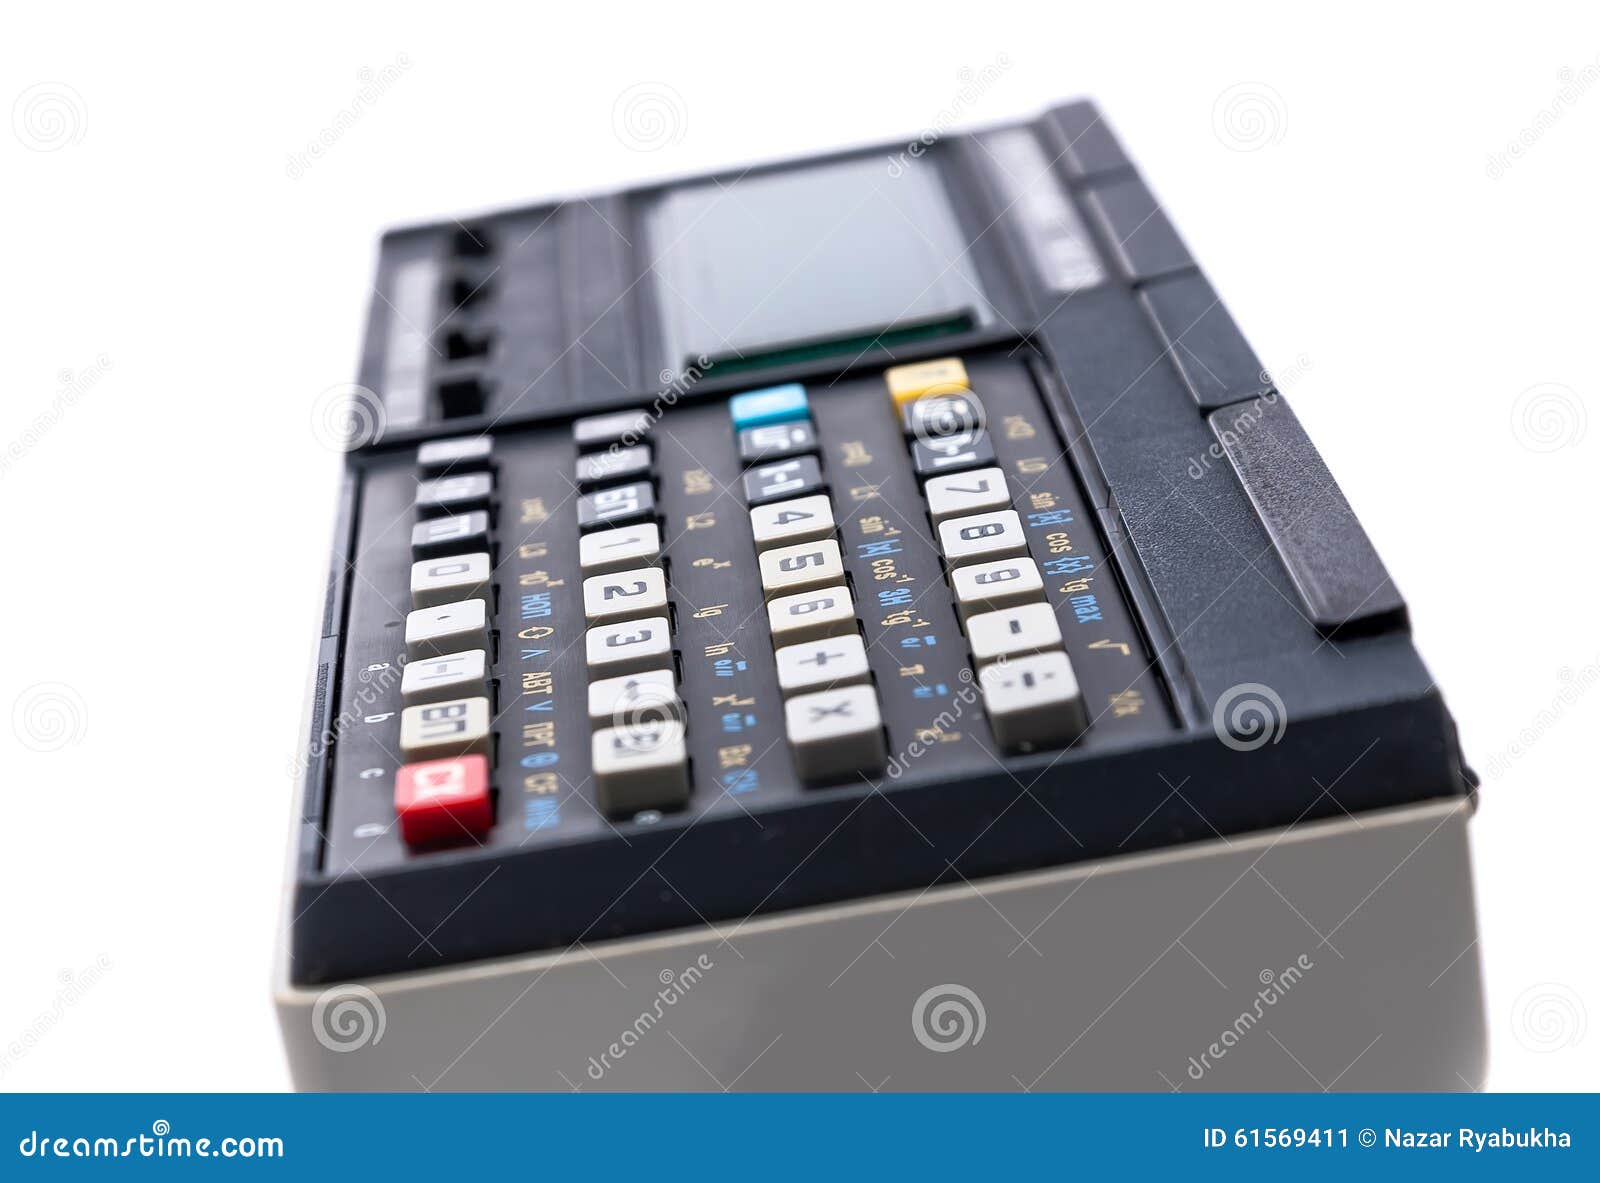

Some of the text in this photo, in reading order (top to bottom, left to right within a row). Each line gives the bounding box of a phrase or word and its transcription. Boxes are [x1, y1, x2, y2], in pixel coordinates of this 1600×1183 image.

[945, 480, 990, 493] 7
[1030, 492, 1060, 510] sin
[773, 511, 815, 525] 4
[959, 522, 1005, 541] 8
[599, 537, 641, 549] 1
[1046, 532, 1073, 555] cos
[428, 562, 470, 576] 0
[779, 552, 825, 572] 5
[974, 568, 1021, 585] 9
[1059, 577, 1094, 594] tg
[604, 581, 648, 600] 2
[521, 592, 552, 619] НОП
[693, 603, 729, 618] lg
[789, 598, 834, 616] 6
[1070, 594, 1104, 624] max
[606, 630, 652, 648] 3
[367, 662, 390, 672] a
[364, 712, 395, 723] b
[421, 703, 467, 739] ВП
